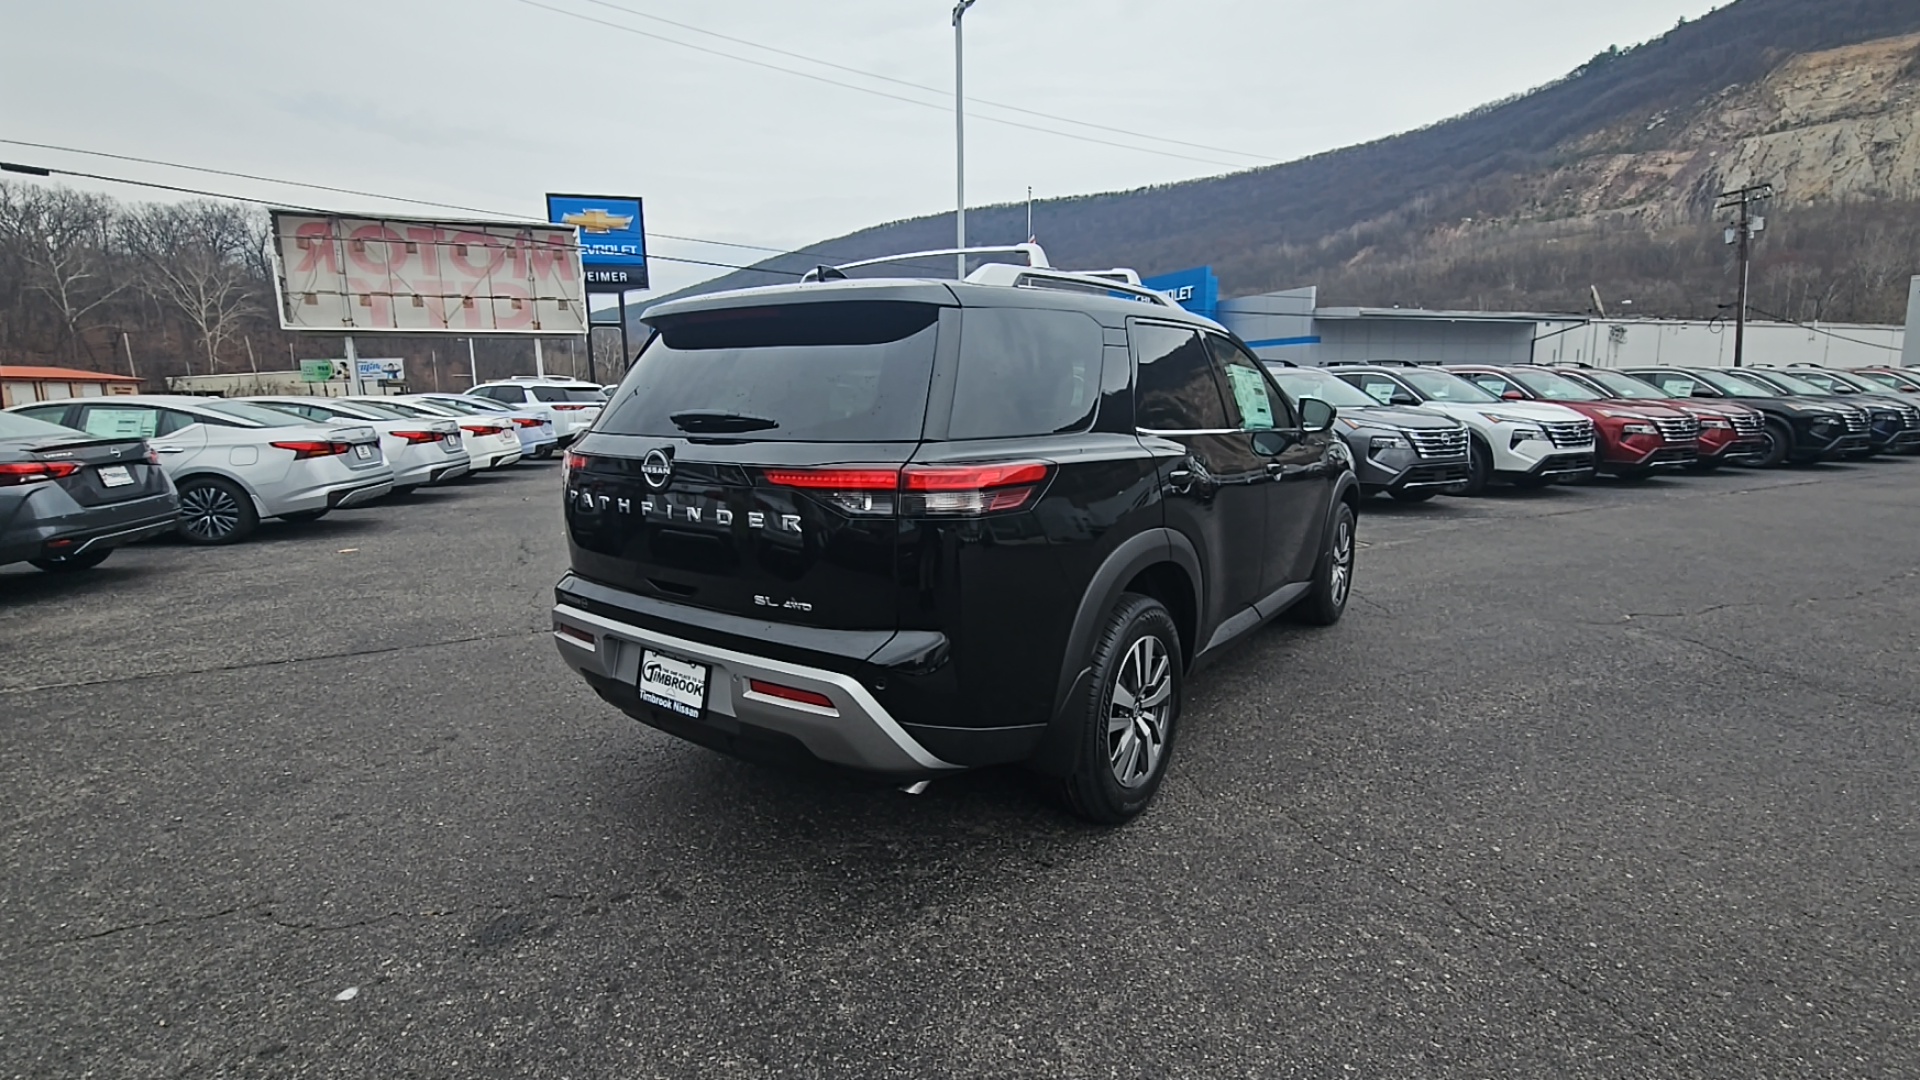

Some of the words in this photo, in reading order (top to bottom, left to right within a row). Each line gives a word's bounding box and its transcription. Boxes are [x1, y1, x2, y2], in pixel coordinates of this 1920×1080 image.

[584, 271, 627, 282] EIMER
[641, 464, 671, 475] NISSAN
[570, 489, 802, 532] PATHFINDER
[754, 595, 779, 607] SL
[642, 661, 704, 696] TIMBROOK
[640, 689, 672, 709] Timbrook
[673, 701, 699, 718] Nissan
